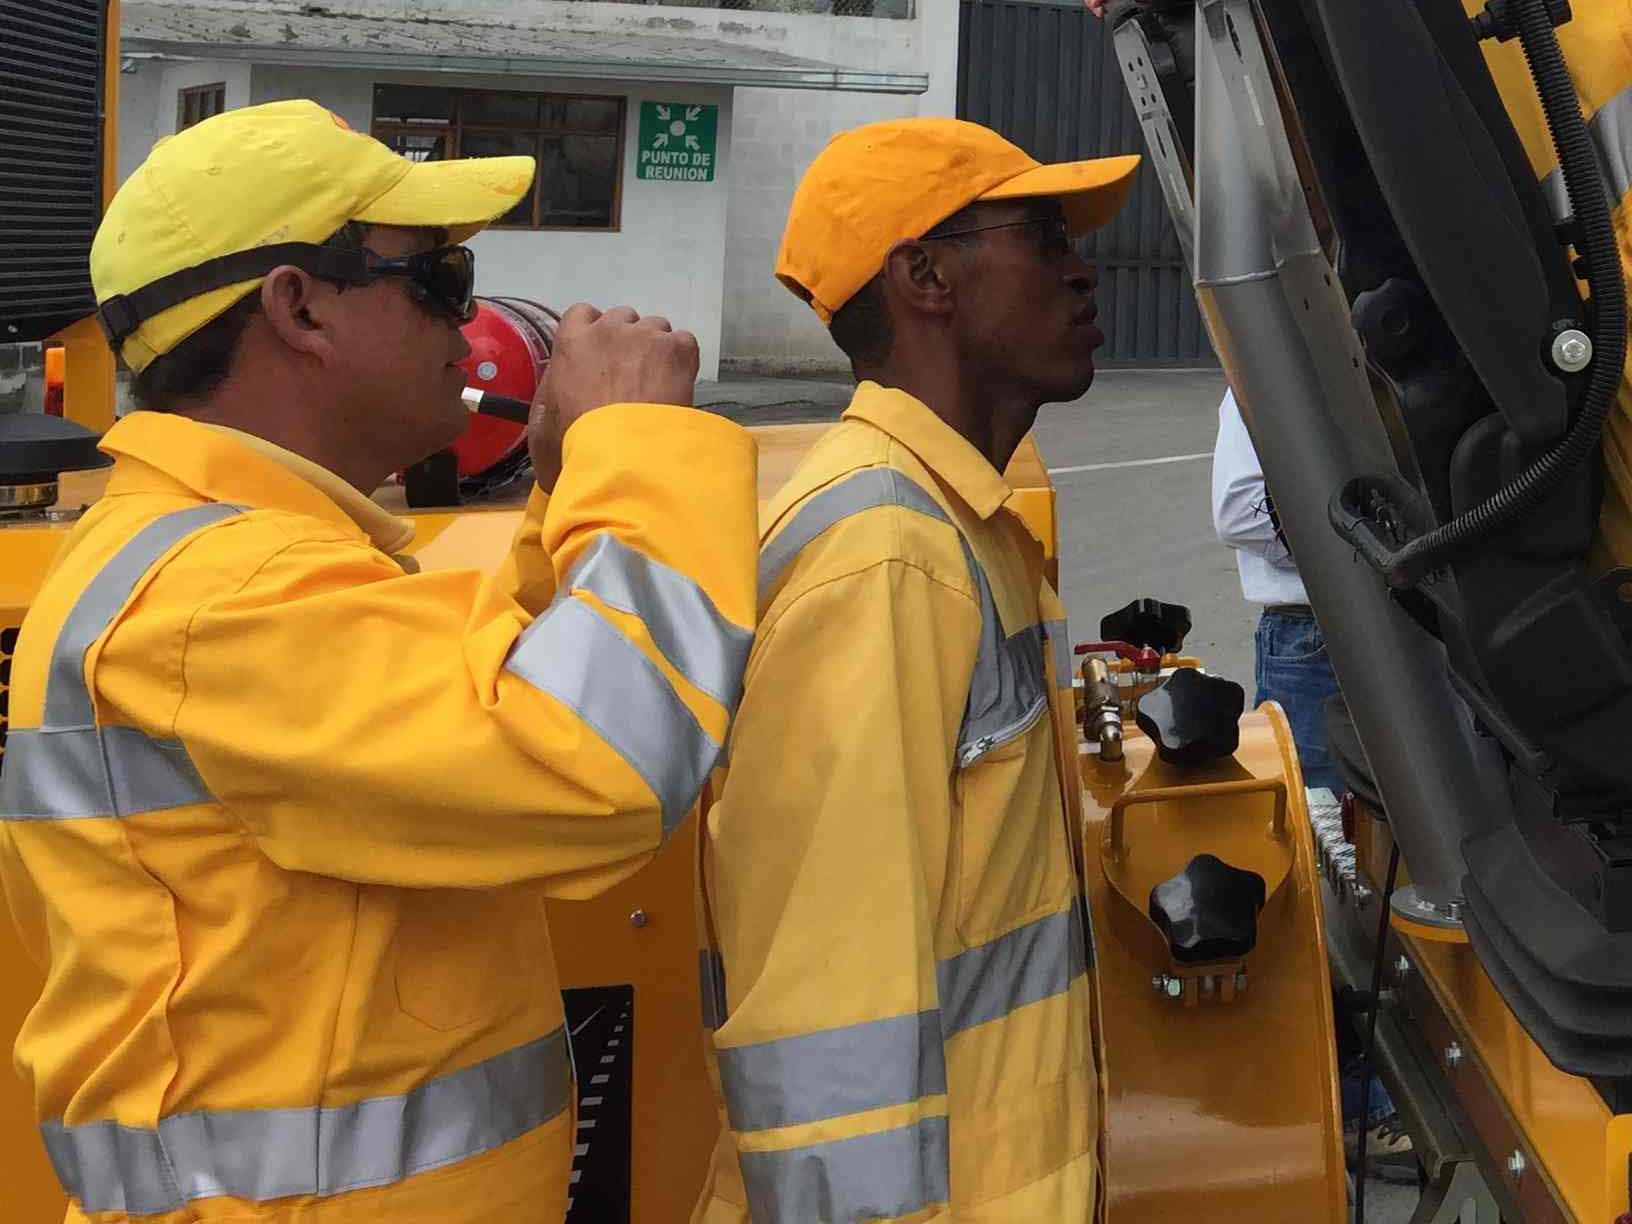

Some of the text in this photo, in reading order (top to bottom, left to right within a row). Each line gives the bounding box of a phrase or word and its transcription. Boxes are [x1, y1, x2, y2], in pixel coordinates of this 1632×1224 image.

[641, 150, 711, 166] PUNTO DE
[645, 165, 708, 180] REUNION
